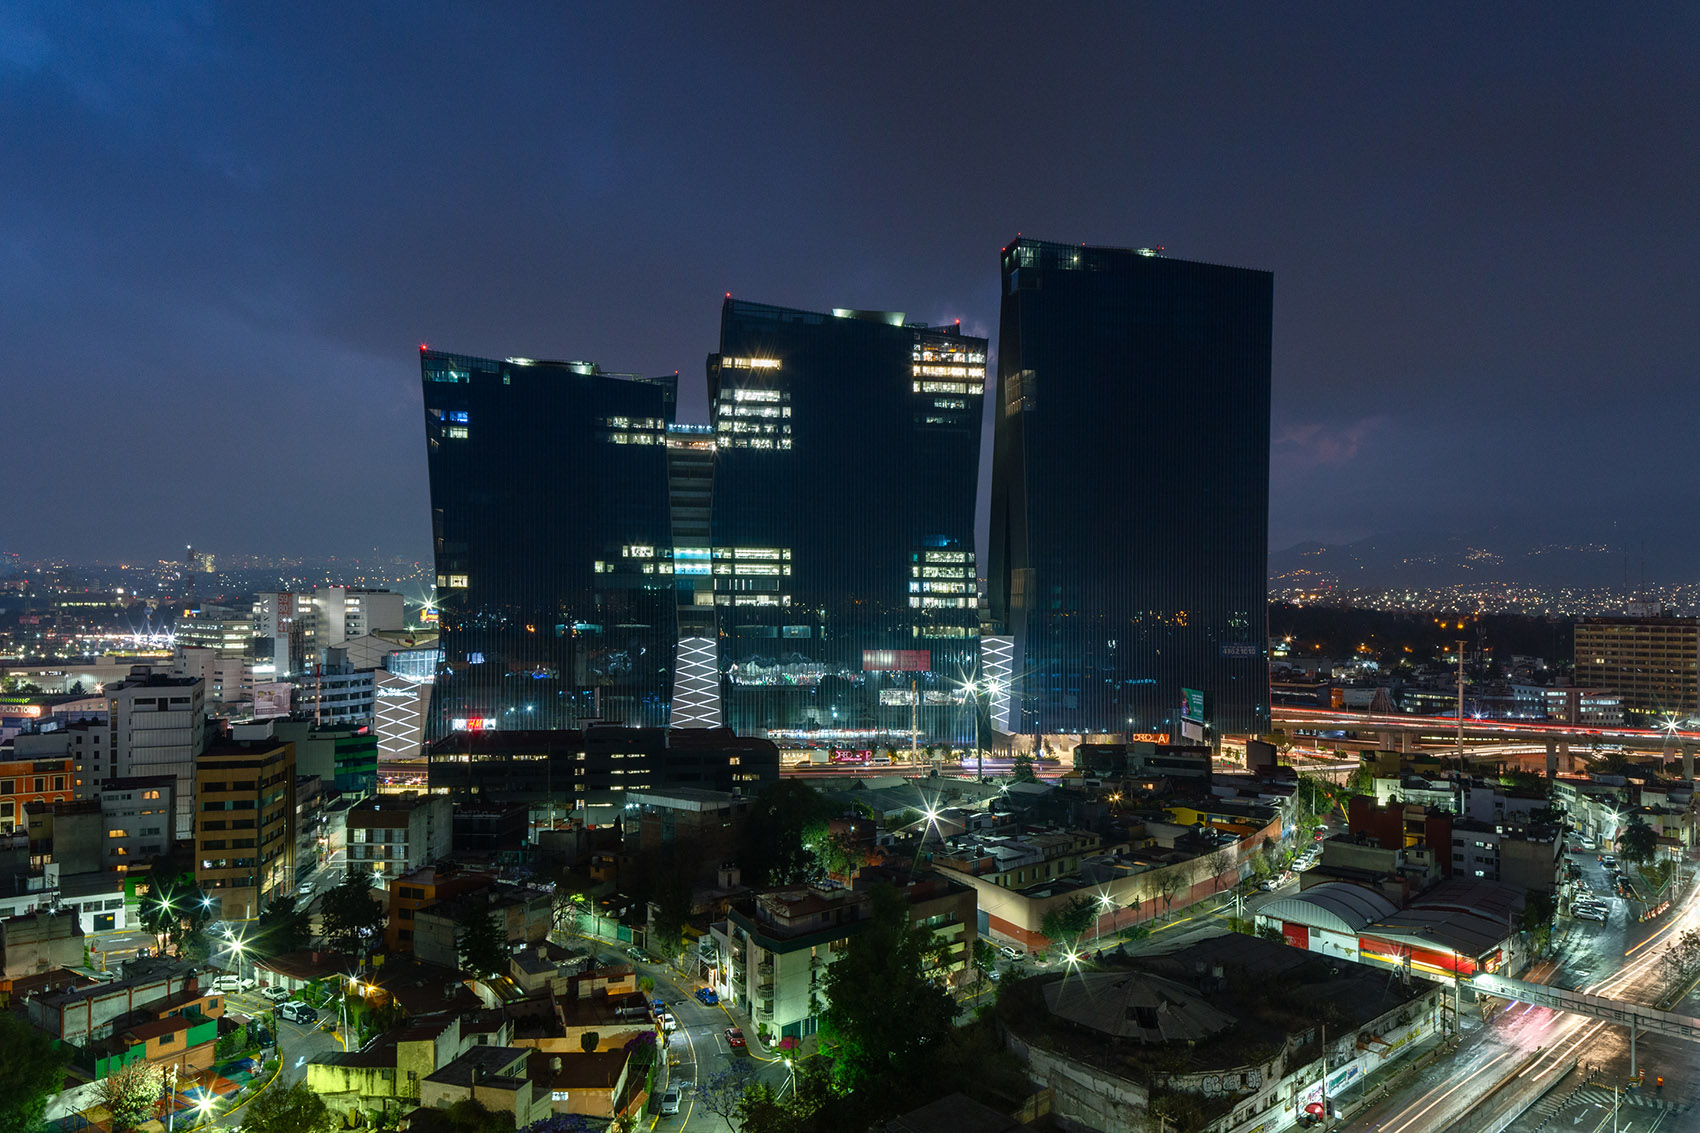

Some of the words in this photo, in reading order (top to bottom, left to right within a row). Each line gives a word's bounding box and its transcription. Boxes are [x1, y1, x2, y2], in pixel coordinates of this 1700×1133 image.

[278, 594, 288, 603] 59
[278, 604, 288, 612] 80
[278, 623, 288, 631] 41
